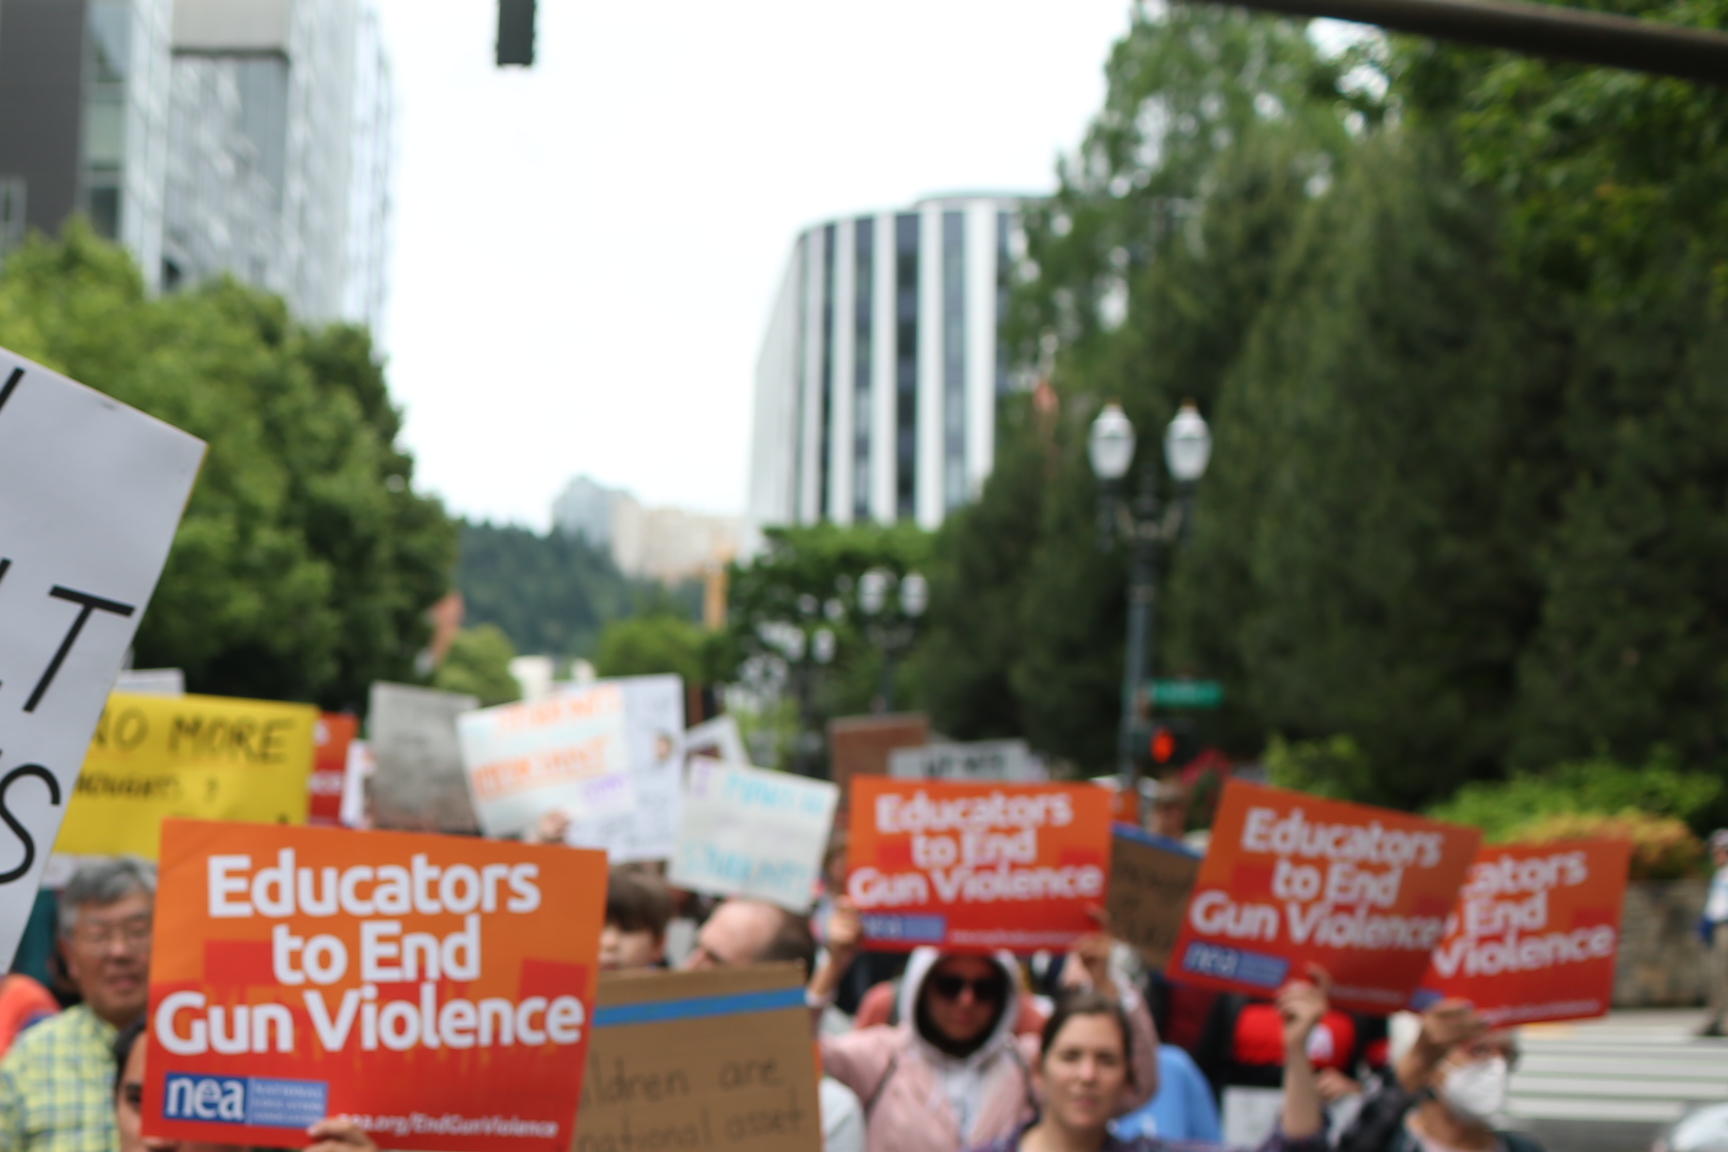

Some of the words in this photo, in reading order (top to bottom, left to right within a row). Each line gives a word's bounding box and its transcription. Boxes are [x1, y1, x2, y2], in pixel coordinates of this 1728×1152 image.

[875, 789, 1073, 834] Educators
[911, 832, 957, 869] to
[961, 826, 1038, 865] End
[1242, 806, 1444, 867] Educators
[208, 848, 540, 918] Educators
[847, 866, 929, 908] Gun
[932, 862, 1104, 904] Violence
[1273, 858, 1322, 901] to
[1324, 864, 1402, 907] End
[1460, 852, 1587, 894] ators
[1190, 891, 1279, 941] Gun
[1285, 901, 1442, 951] Violence
[1464, 890, 1548, 934] End
[274, 923, 348, 985] to
[360, 913, 481, 982] End
[1432, 922, 1616, 977] Violence
[155, 990, 293, 1055] Gun
[303, 978, 584, 1053] Violence
[167, 1076, 245, 1121] nea
